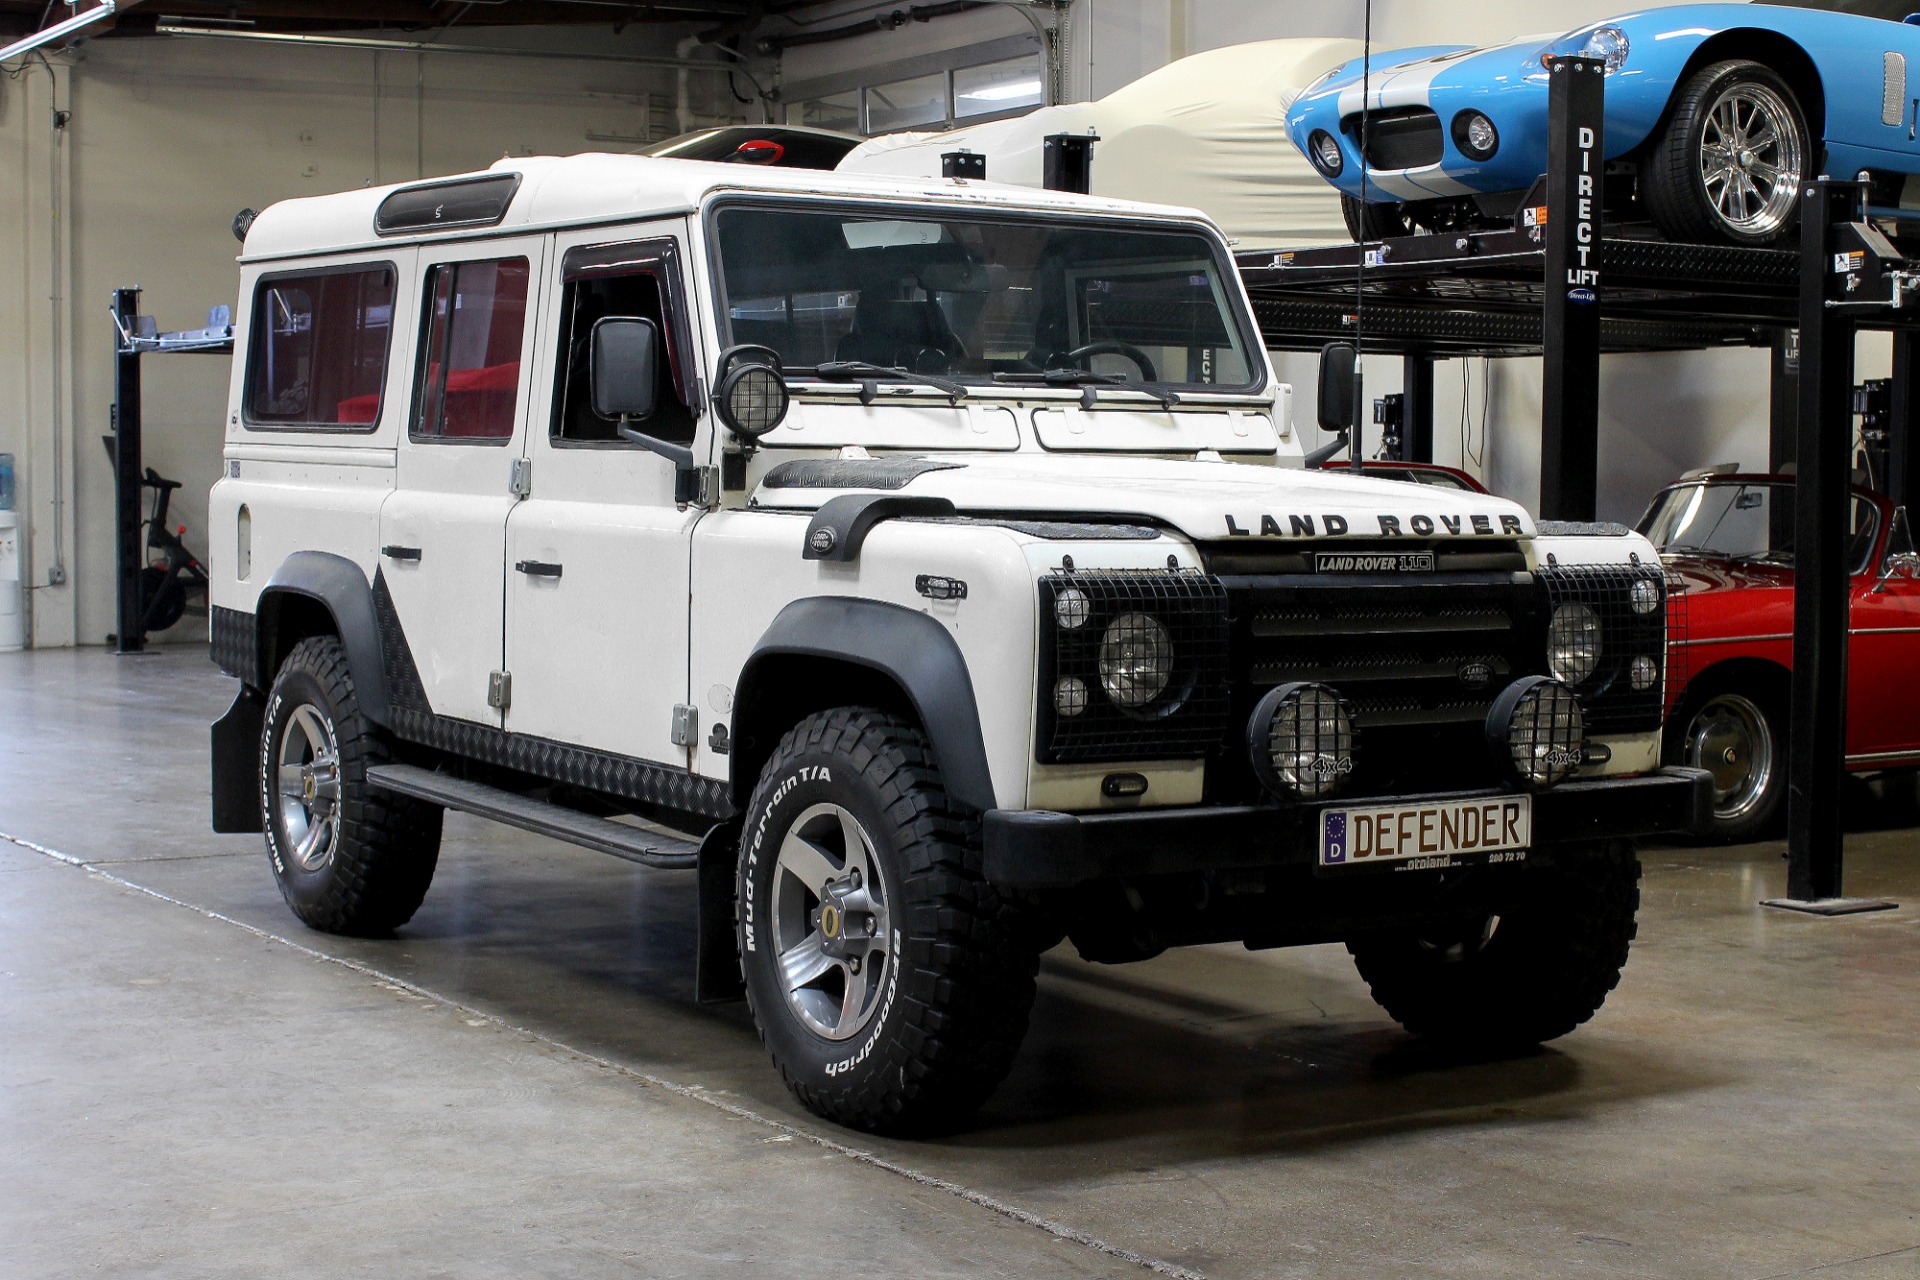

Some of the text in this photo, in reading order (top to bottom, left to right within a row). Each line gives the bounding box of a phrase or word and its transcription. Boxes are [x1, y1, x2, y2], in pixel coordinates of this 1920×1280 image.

[1577, 127, 1594, 267] DIRECT
[1567, 268, 1599, 286] LIFT
[1224, 514, 1525, 537] LAND ROVER
[1319, 555, 1432, 571] LAND ROVER 110
[1311, 758, 1353, 774] 4x4
[1543, 750, 1582, 765] 4x4
[1330, 803, 1520, 859] D DEFENDER
[745, 765, 832, 952] Mud-Terrain T/A
[825, 928, 901, 1078] BFGoodrich
